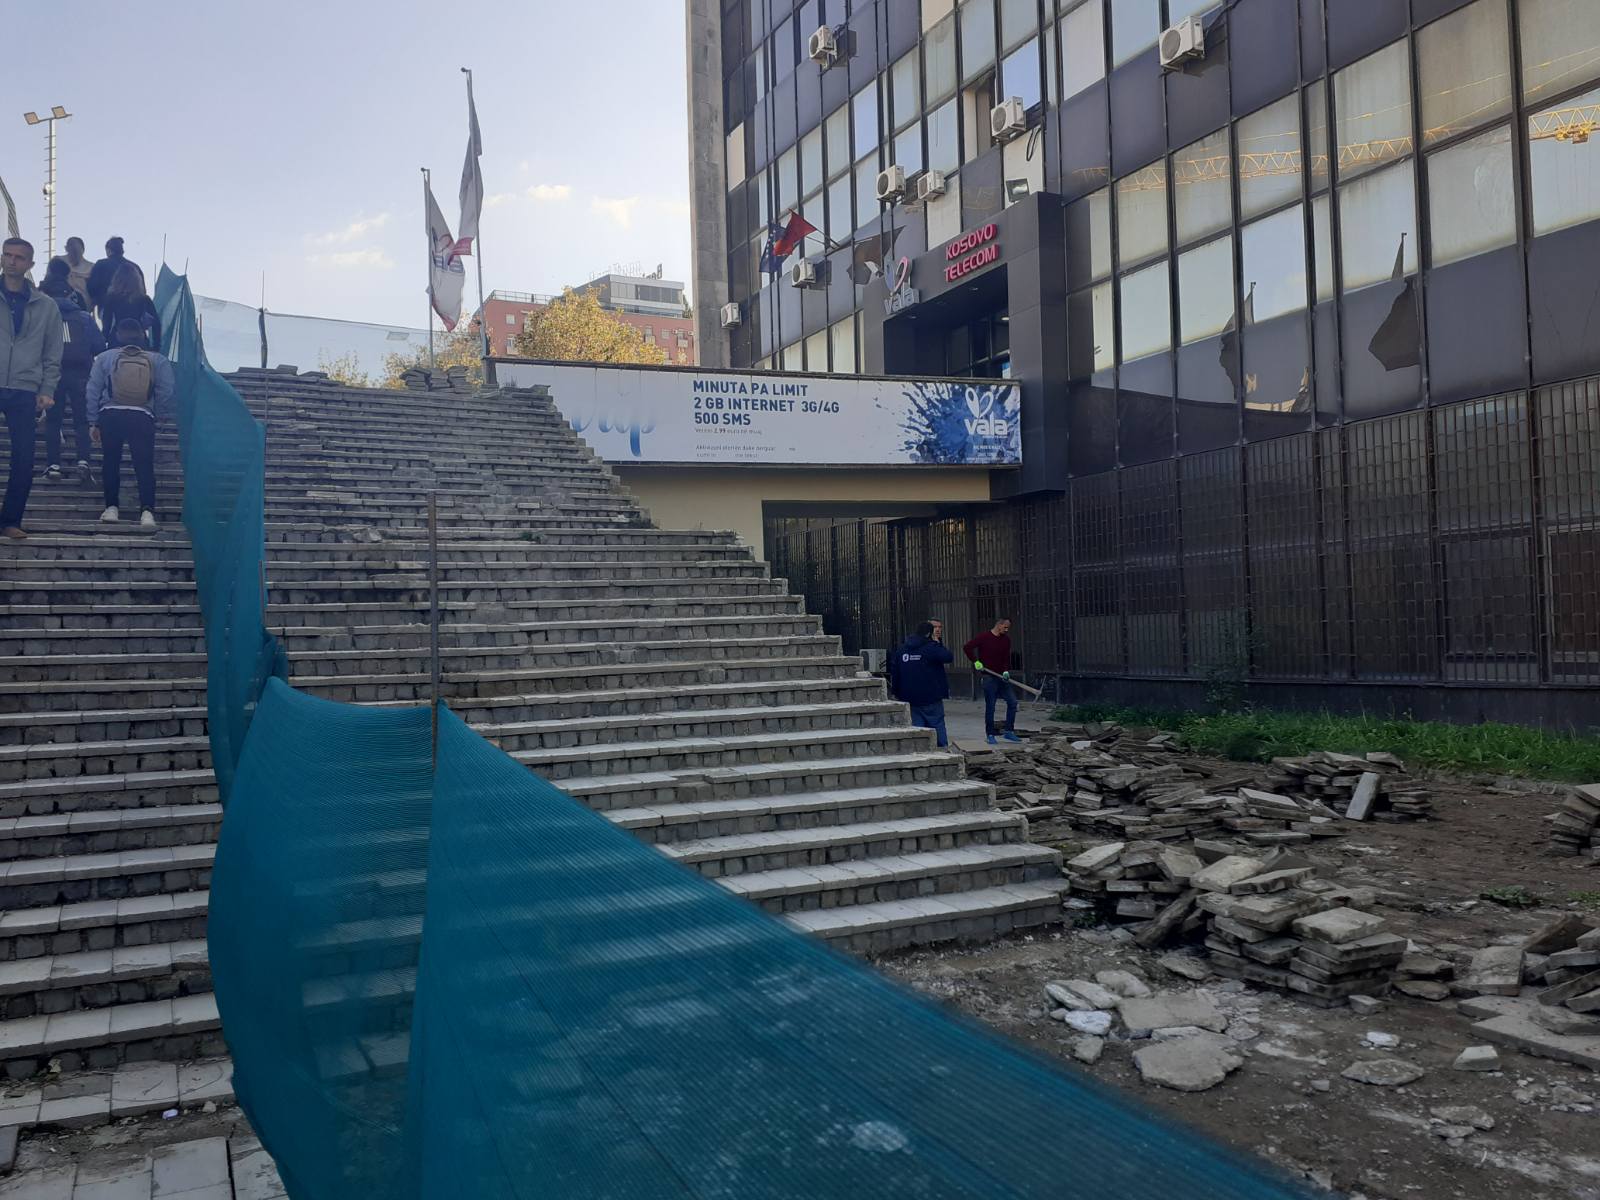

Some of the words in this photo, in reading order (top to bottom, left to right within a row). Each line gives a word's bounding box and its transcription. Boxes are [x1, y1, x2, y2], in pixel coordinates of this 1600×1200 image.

[945, 223, 998, 261] KOSOVO
[944, 243, 1001, 283] TELECOM
[884, 284, 917, 315] vala
[693, 380, 748, 395] MINUTA
[751, 382, 769, 396] PA
[773, 383, 808, 397] LIMIT
[694, 397, 702, 409] 2
[705, 397, 724, 410] GB
[729, 398, 795, 412] INTERNET
[801, 400, 840, 414] 3G/4G
[694, 412, 719, 425] 500
[722, 413, 751, 426] SMS
[964, 411, 1008, 436] vala
